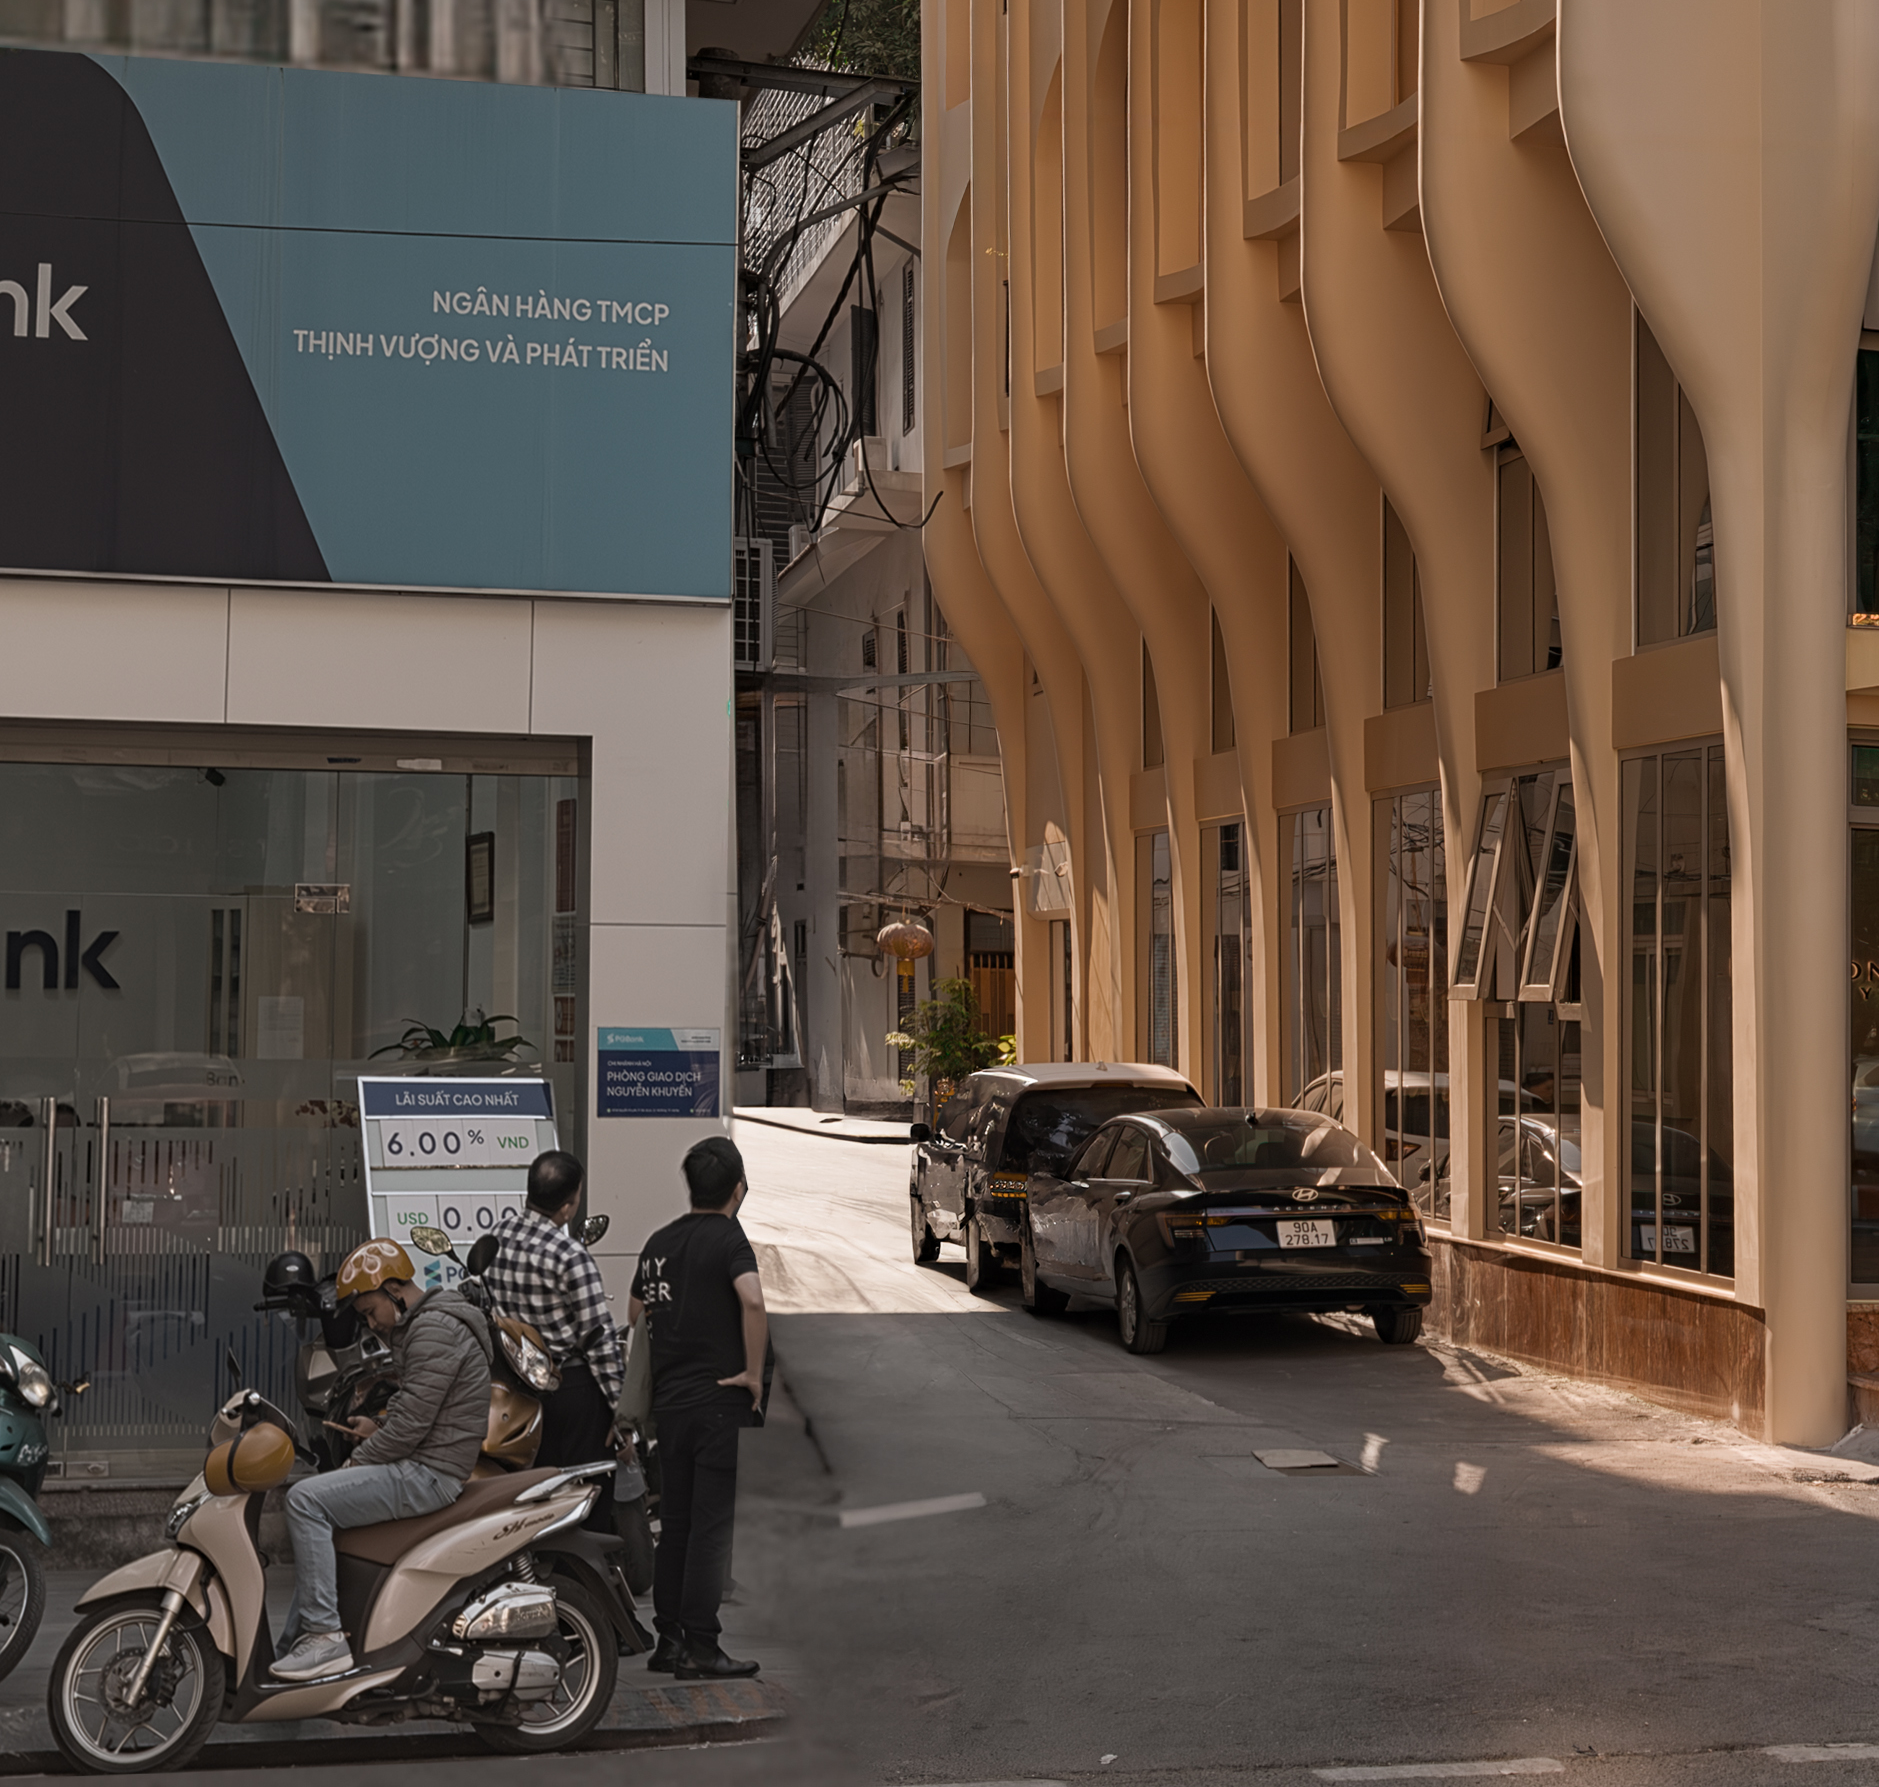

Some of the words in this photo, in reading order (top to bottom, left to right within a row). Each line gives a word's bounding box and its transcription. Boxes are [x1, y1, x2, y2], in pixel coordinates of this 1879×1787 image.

[432, 286, 510, 318] NGÂN
[517, 289, 592, 321] HÀNG
[597, 300, 670, 326] TMCP
[293, 329, 374, 361] THỊNH
[380, 333, 480, 366] VƯỢNG
[485, 335, 520, 365] VÀ
[526, 338, 592, 368] PHÁT
[597, 338, 669, 372] TRIỂN
[6, 910, 120, 989] nk
[607, 1069, 646, 1082] PHÒNG
[647, 1071, 674, 1082] GIAO
[675, 1071, 701, 1084] DỊCH
[395, 1091, 416, 1106] LÃI
[417, 1090, 450, 1106] SUẤT
[453, 1094, 482, 1106] CAO
[485, 1090, 519, 1106] NHẤT
[497, 1136, 529, 1149] VND
[397, 1212, 428, 1225] USD
[1293, 1222, 1318, 1233] 90A
[1285, 1233, 1329, 1246] 278.17
